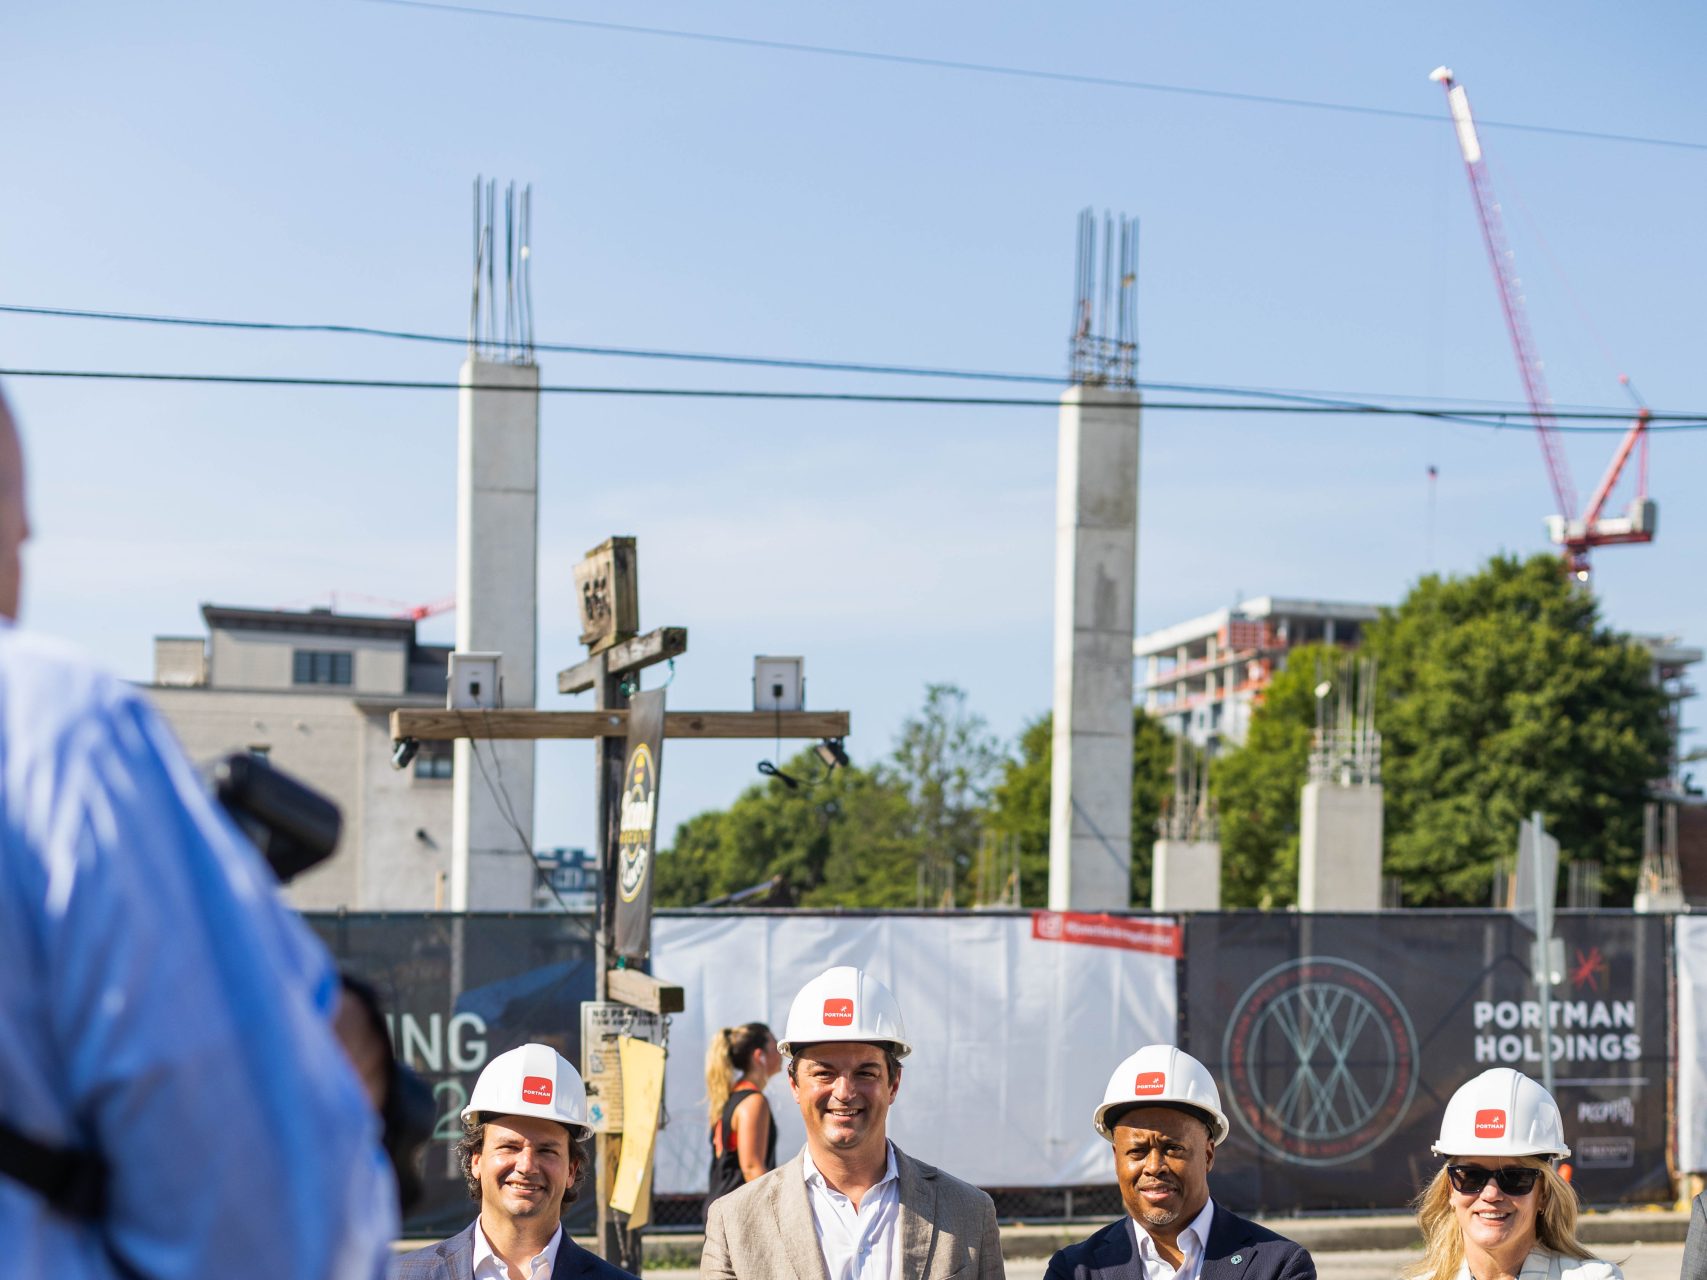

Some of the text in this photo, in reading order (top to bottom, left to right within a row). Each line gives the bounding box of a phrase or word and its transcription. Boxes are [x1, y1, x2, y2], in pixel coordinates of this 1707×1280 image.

[592, 1009, 608, 1017] NO
[1473, 1000, 1636, 1030] PORTMAN
[1474, 1033, 1643, 1063] HOLDINGS
[523, 1089, 551, 1098] PORTMAN
